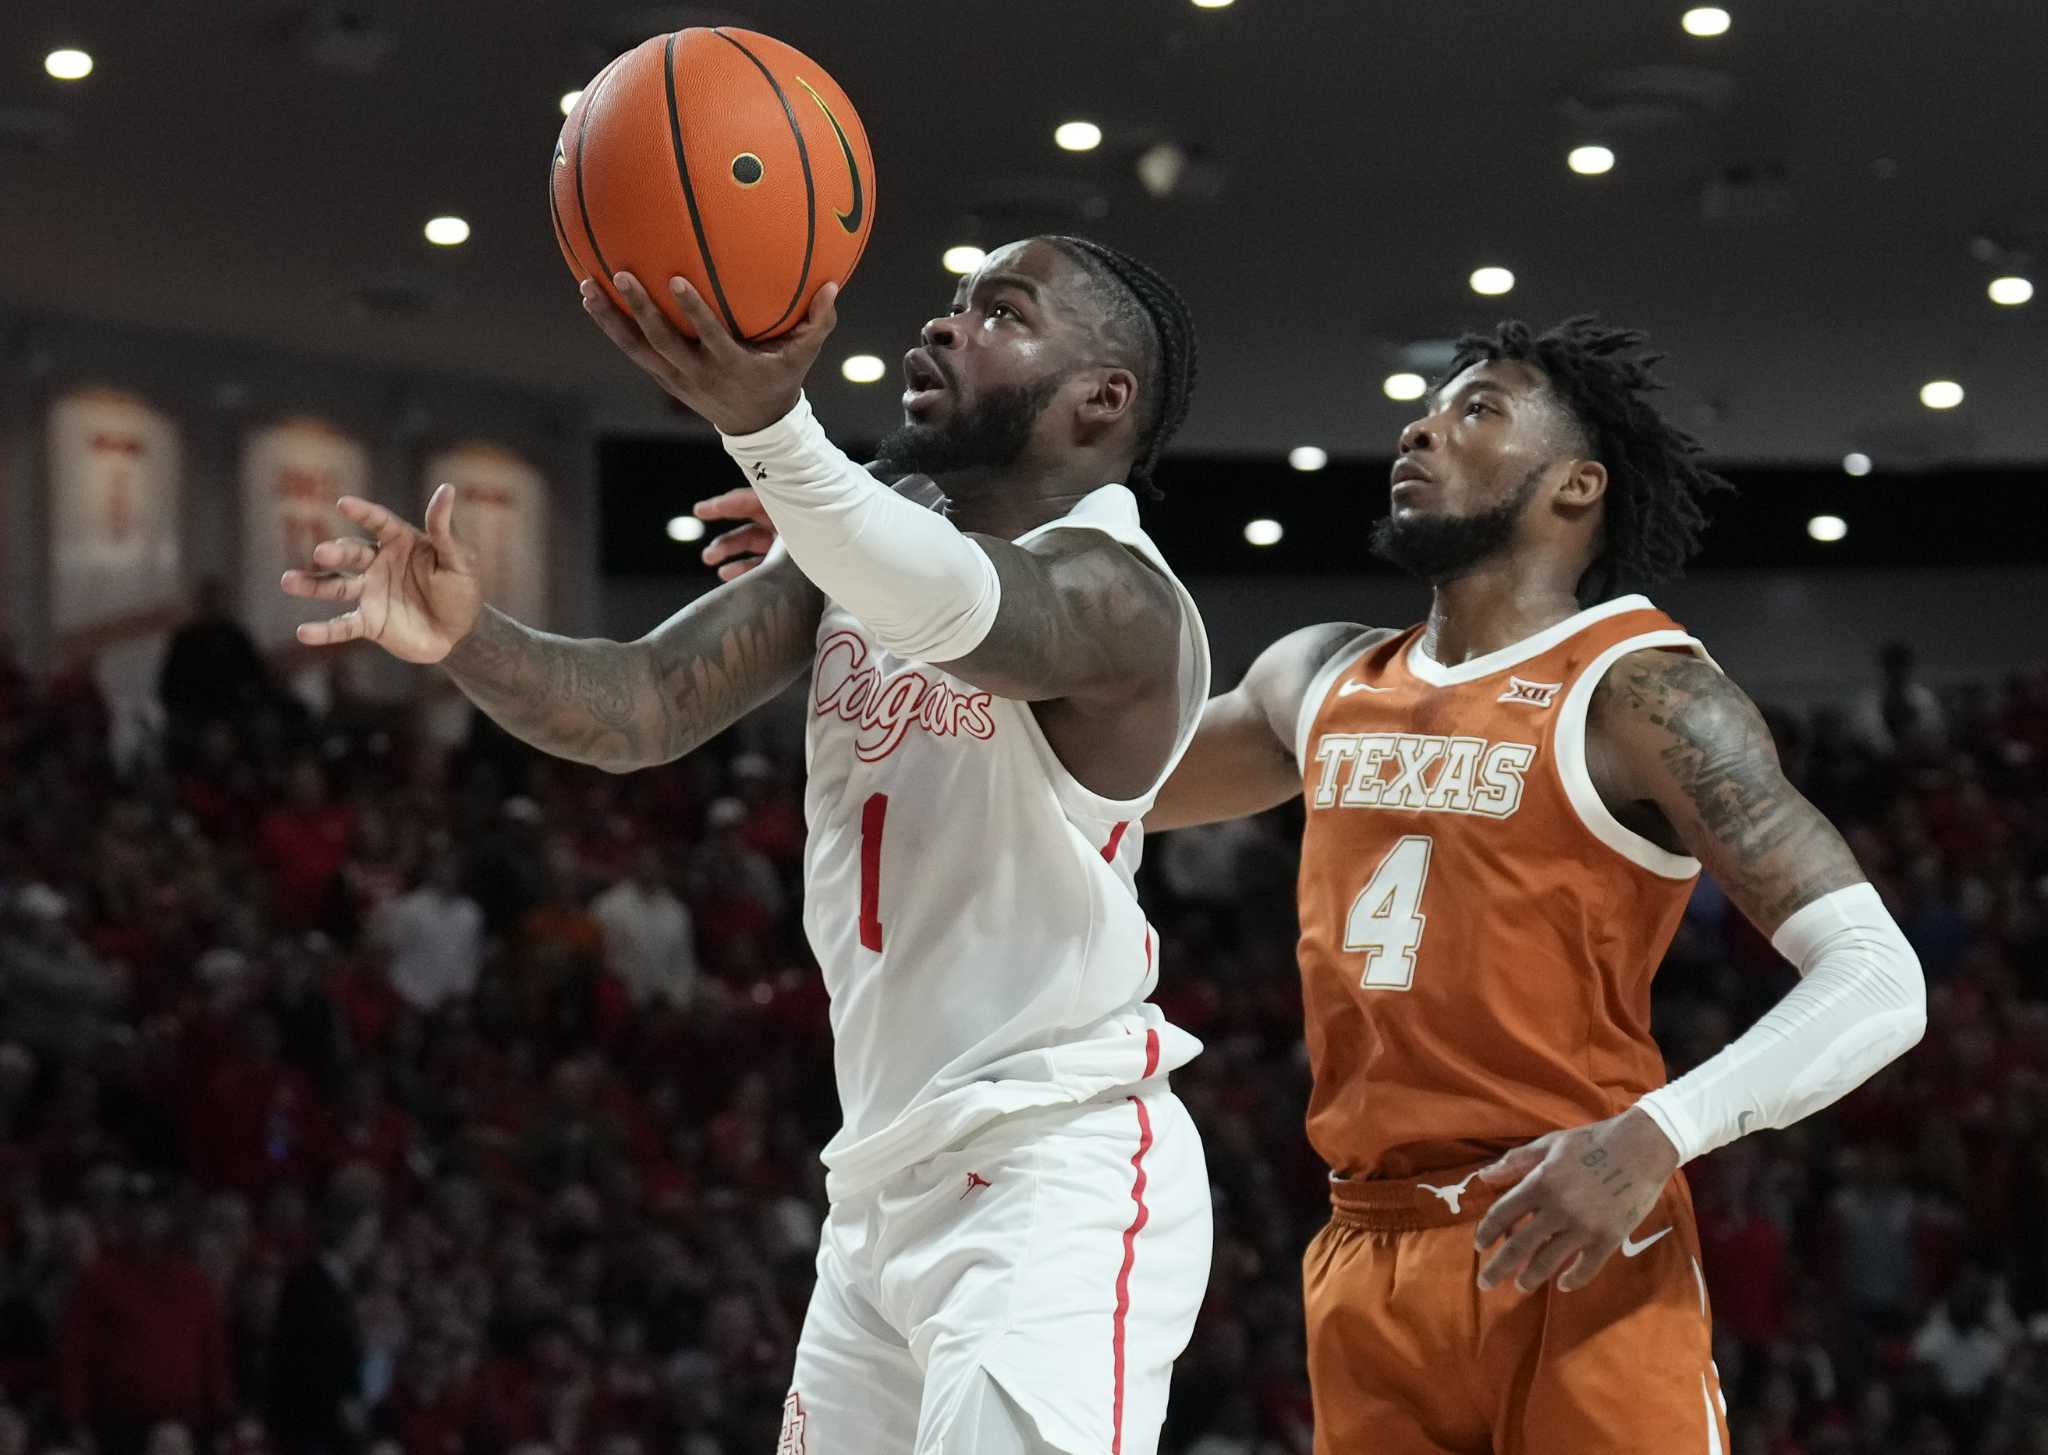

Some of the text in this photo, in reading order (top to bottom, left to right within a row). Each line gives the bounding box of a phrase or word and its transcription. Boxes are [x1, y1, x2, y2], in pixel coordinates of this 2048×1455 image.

[1313, 733, 1537, 820] TEXAS
[859, 792, 888, 953] 1
[1343, 834, 1433, 992] 4
